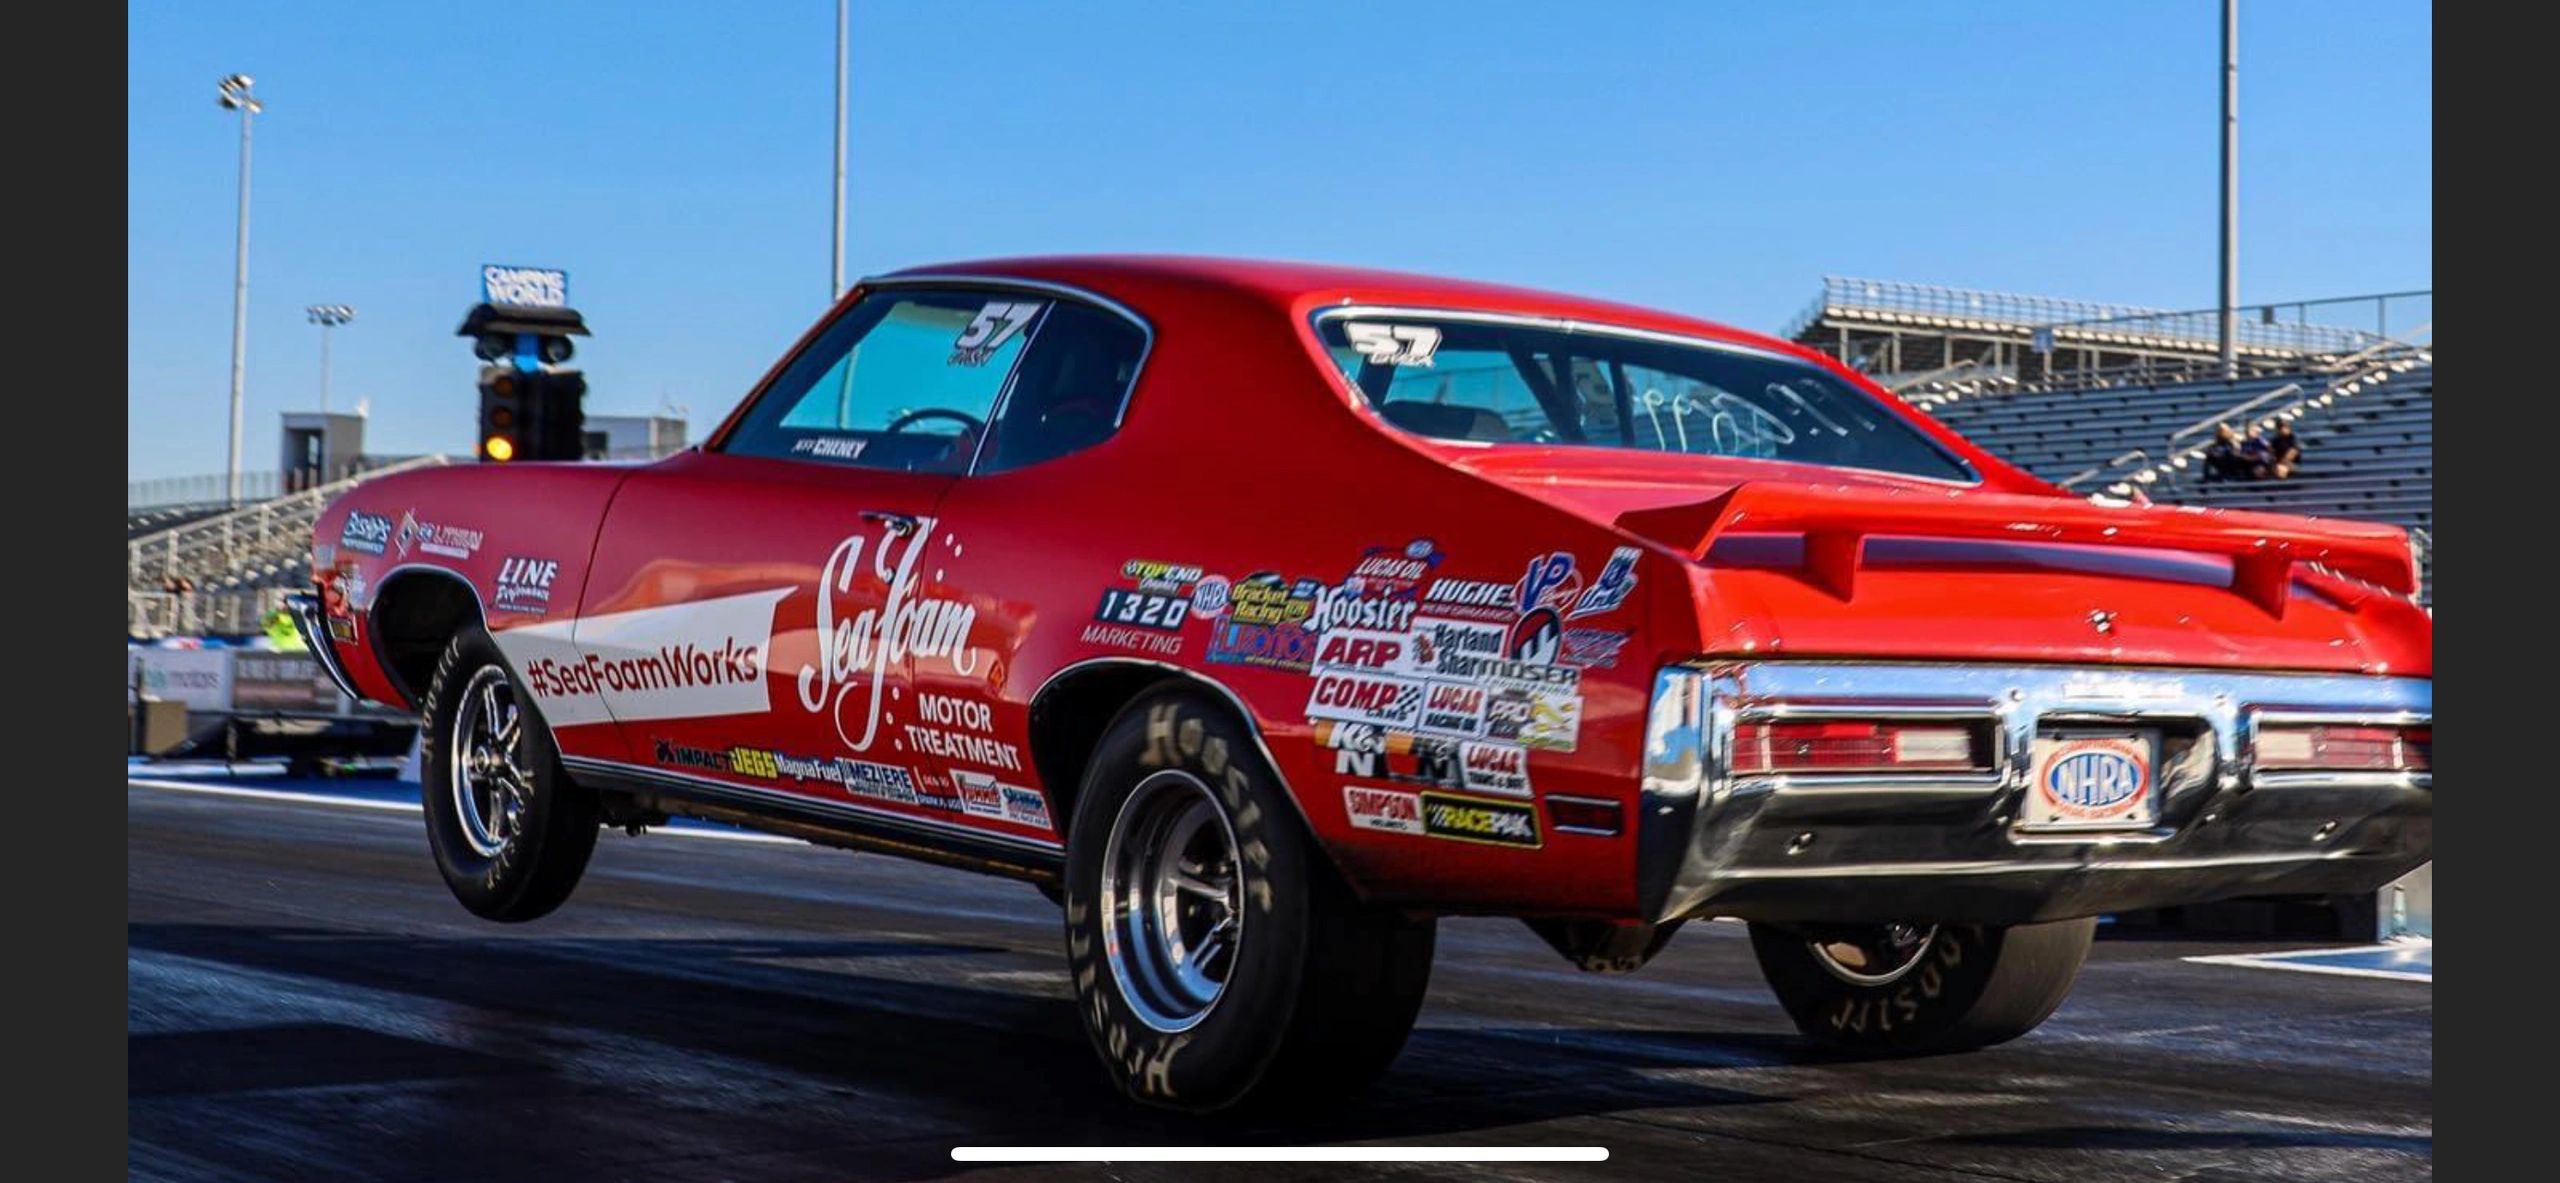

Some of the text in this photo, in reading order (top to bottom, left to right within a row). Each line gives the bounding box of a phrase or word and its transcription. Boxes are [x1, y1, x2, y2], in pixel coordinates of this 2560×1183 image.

[486, 281, 565, 306] WORLD
[957, 301, 1041, 349] 57
[1345, 322, 1440, 355] 57
[498, 558, 558, 588] LINE
[1102, 590, 1189, 627] 1320
[1301, 585, 1418, 632] Hoosier
[1081, 624, 1183, 656] MARKETING
[1320, 636, 1401, 668] ARP
[1433, 623, 1503, 653] Harland
[528, 637, 759, 698] #SeaFoamWorks
[1316, 676, 1399, 711] COMP
[1428, 686, 1484, 715] LUCAS
[918, 693, 994, 733] MOTOR
[731, 747, 778, 779] JEGS
[904, 724, 1022, 771] TREATMENT
[1467, 745, 1521, 775] LUCAS
[774, 752, 844, 783] MagnaFuel
[848, 760, 911, 789] MEZIERE
[2057, 752, 2135, 806] NHRA
[1349, 789, 1419, 821] SIMPSON
[1440, 803, 1533, 838] RACEPAK
